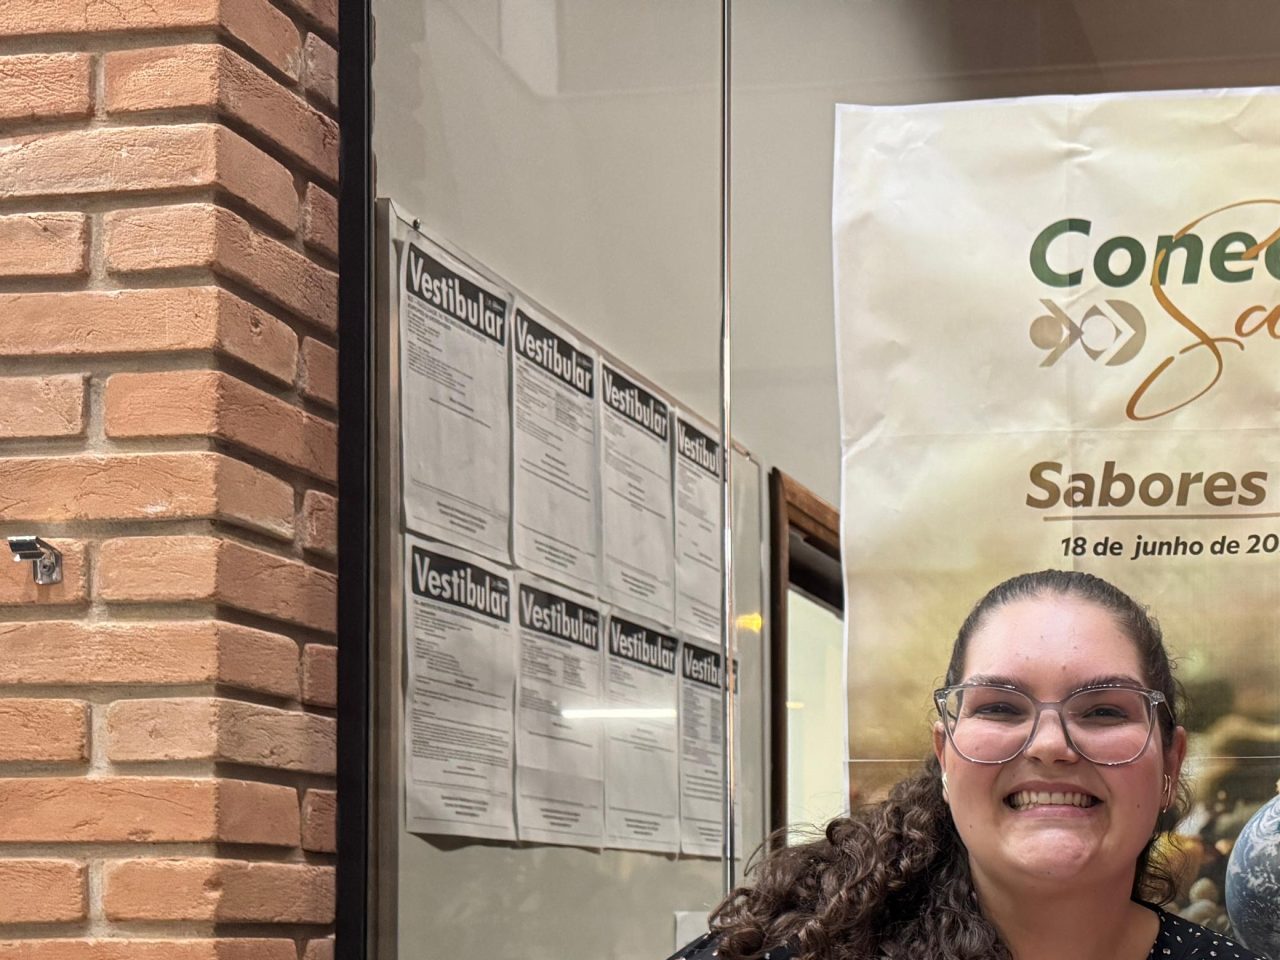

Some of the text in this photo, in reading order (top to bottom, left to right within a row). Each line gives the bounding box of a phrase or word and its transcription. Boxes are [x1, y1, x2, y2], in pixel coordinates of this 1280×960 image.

[410, 250, 503, 340] Vestibular
[517, 316, 593, 395] Vestibular
[603, 370, 668, 440] Vestibular
[678, 423, 720, 474] Vestibul
[1025, 461, 1268, 510] Sabores
[1060, 536, 1088, 557] 18
[1092, 535, 1123, 557] de
[1132, 535, 1203, 560] junho
[1209, 534, 1240, 556] de
[414, 553, 508, 618] Vestibular
[521, 591, 599, 648] Vestibular
[611, 622, 676, 671] Vestibular
